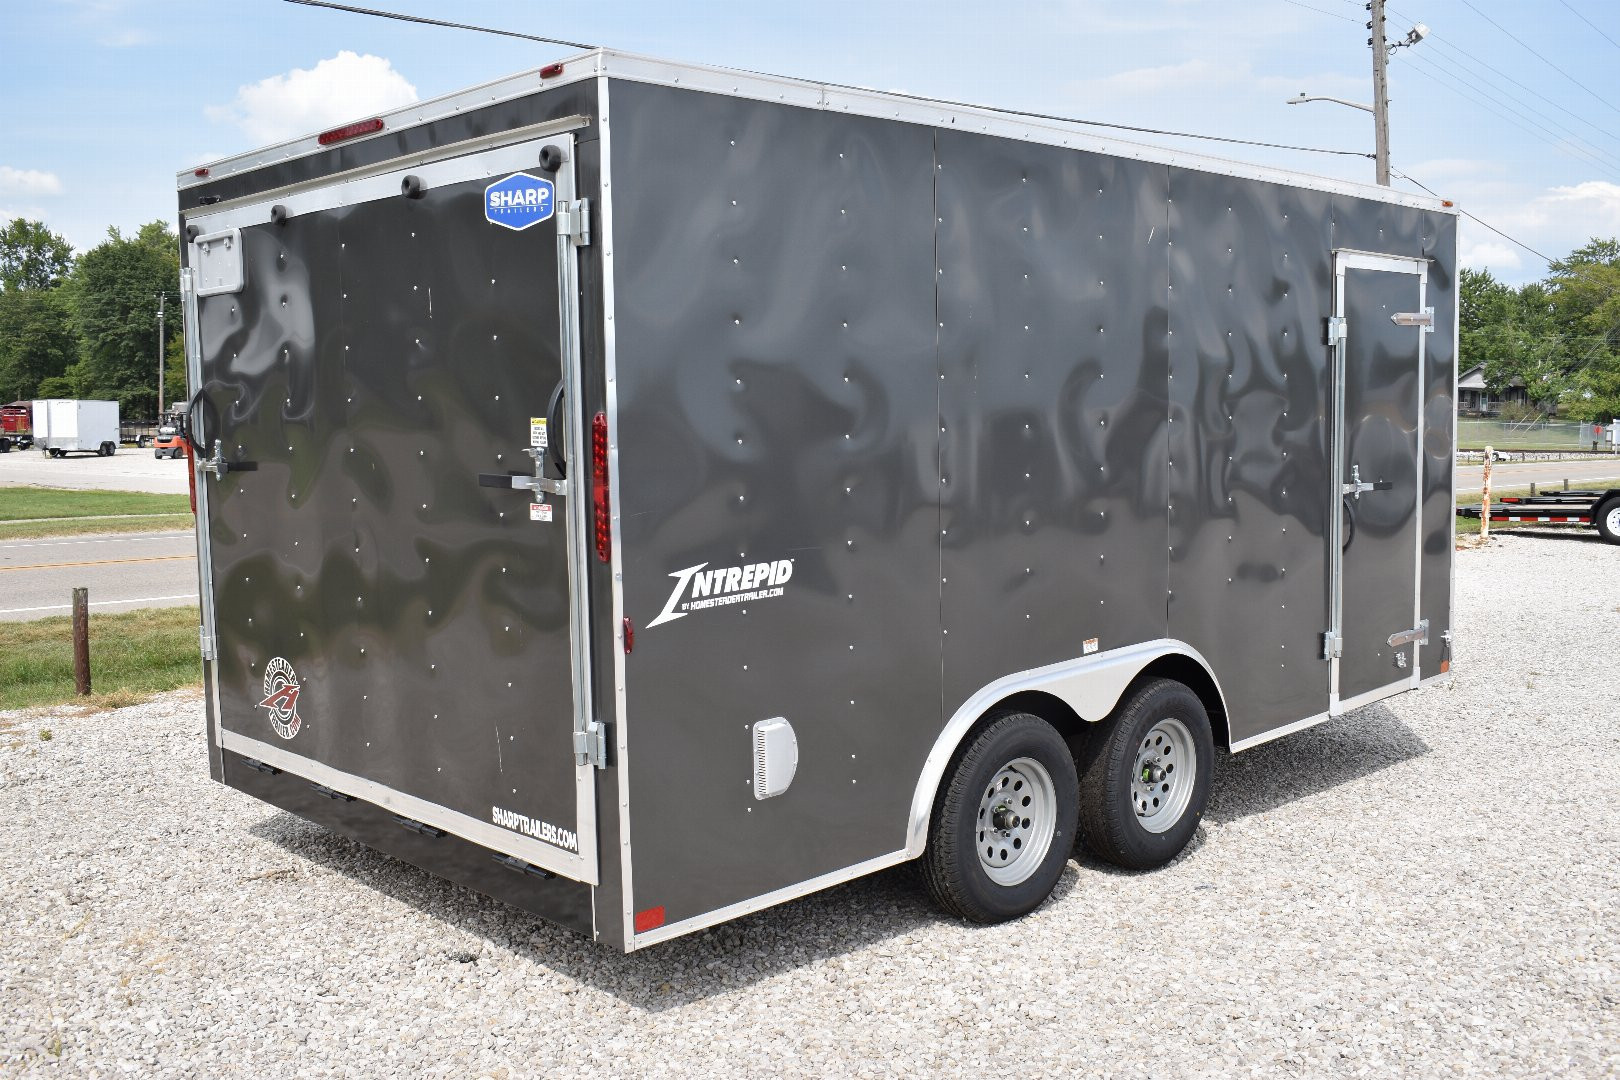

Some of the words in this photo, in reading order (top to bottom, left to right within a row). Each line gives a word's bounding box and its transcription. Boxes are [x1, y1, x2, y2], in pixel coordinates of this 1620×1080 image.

[490, 187, 549, 207] SHARP
[645, 558, 793, 629] INTREPID
[681, 603, 690, 611] BY
[690, 587, 784, 611] HOMESTEADERTRAILER.COM
[492, 806, 578, 852] SHARPTRAILERS.COM
